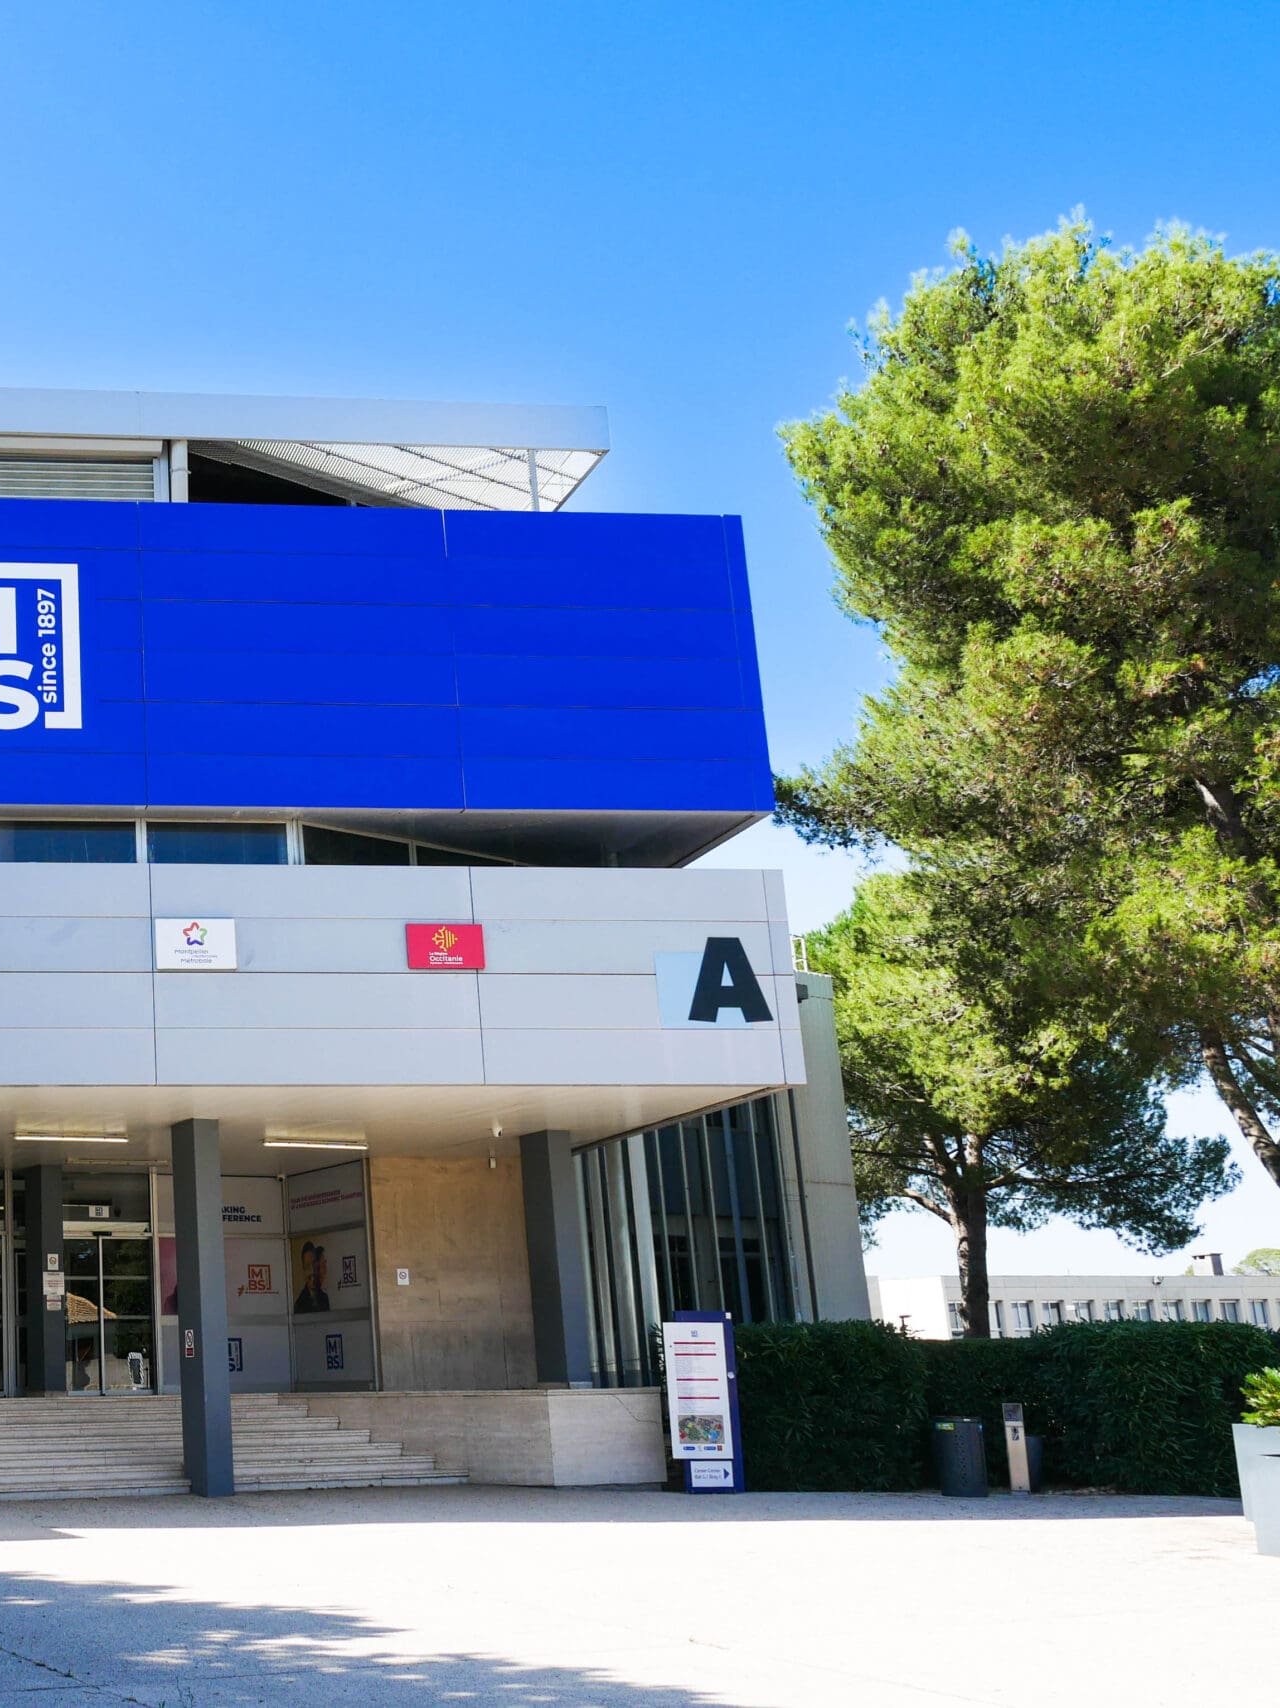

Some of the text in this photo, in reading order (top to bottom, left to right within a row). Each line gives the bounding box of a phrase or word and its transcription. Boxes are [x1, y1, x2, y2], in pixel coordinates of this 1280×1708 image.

[36, 588, 58, 704] since 1897
[688, 937, 774, 1023] A
